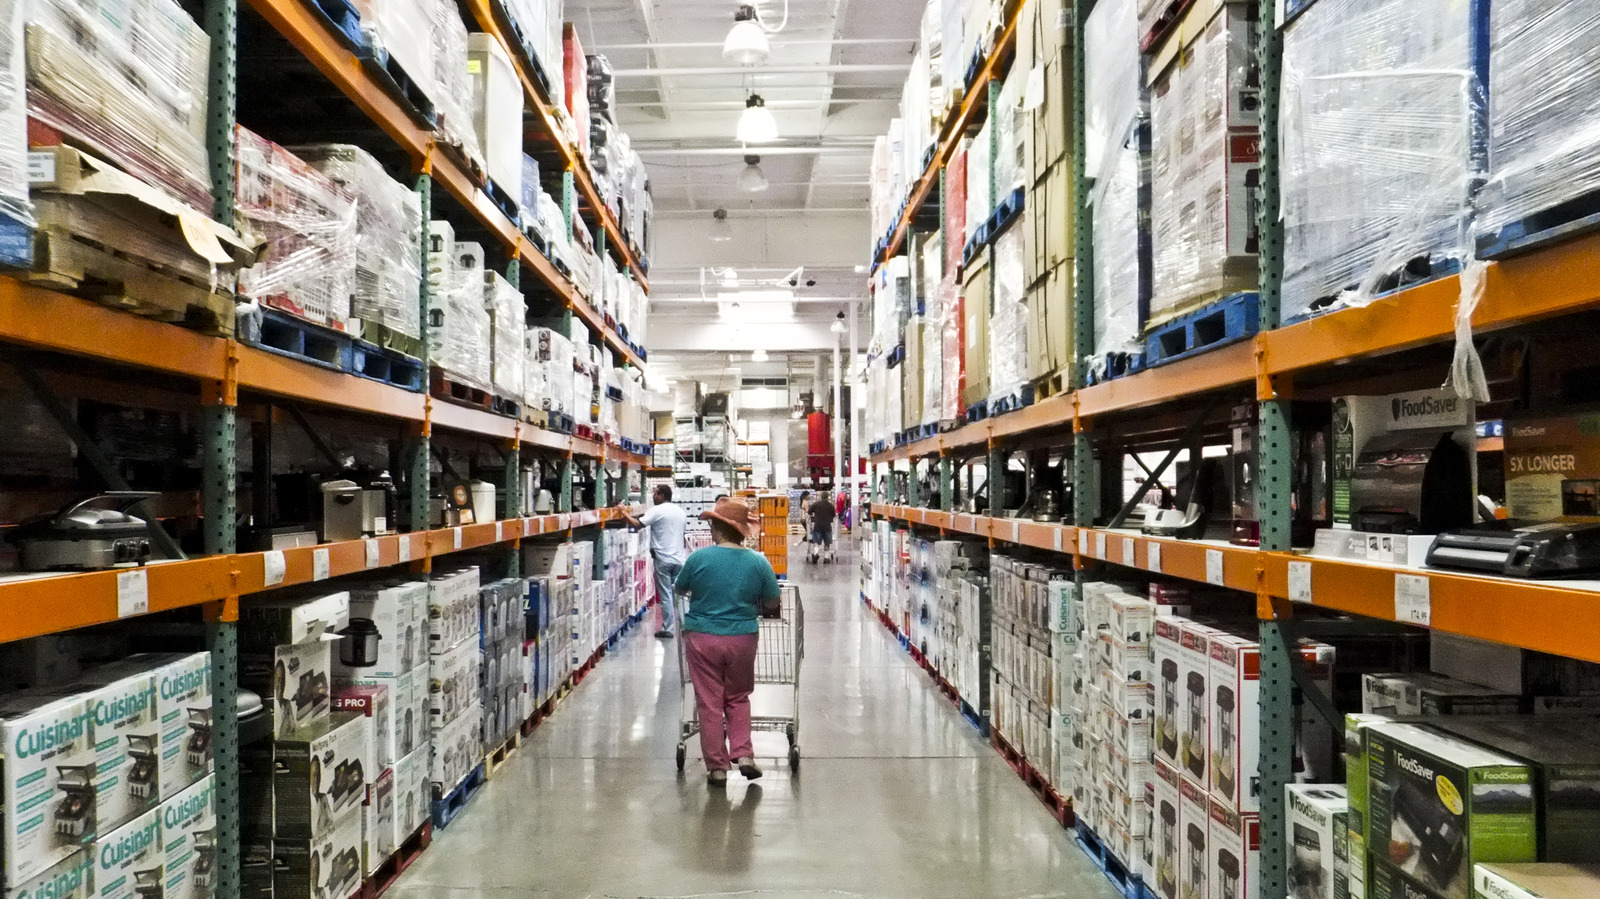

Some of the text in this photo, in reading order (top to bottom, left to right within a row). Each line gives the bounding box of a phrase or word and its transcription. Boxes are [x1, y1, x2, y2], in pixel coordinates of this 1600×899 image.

[1401, 396, 1457, 417] FoodSaver
[1512, 426, 1546, 438] FoodSaver
[1527, 454, 1576, 472] LONGER
[1059, 587, 1068, 630] Cuisinart
[160, 665, 211, 700] Cuisinart
[95, 685, 156, 727] Cuisinart
[344, 698, 366, 708] PRO
[15, 708, 95, 759] Cuisinart
[1397, 752, 1434, 781] FoodSaver
[164, 783, 216, 829] Cuisinart
[1295, 795, 1326, 827] FoodSaver
[101, 817, 161, 869] Cuisinart
